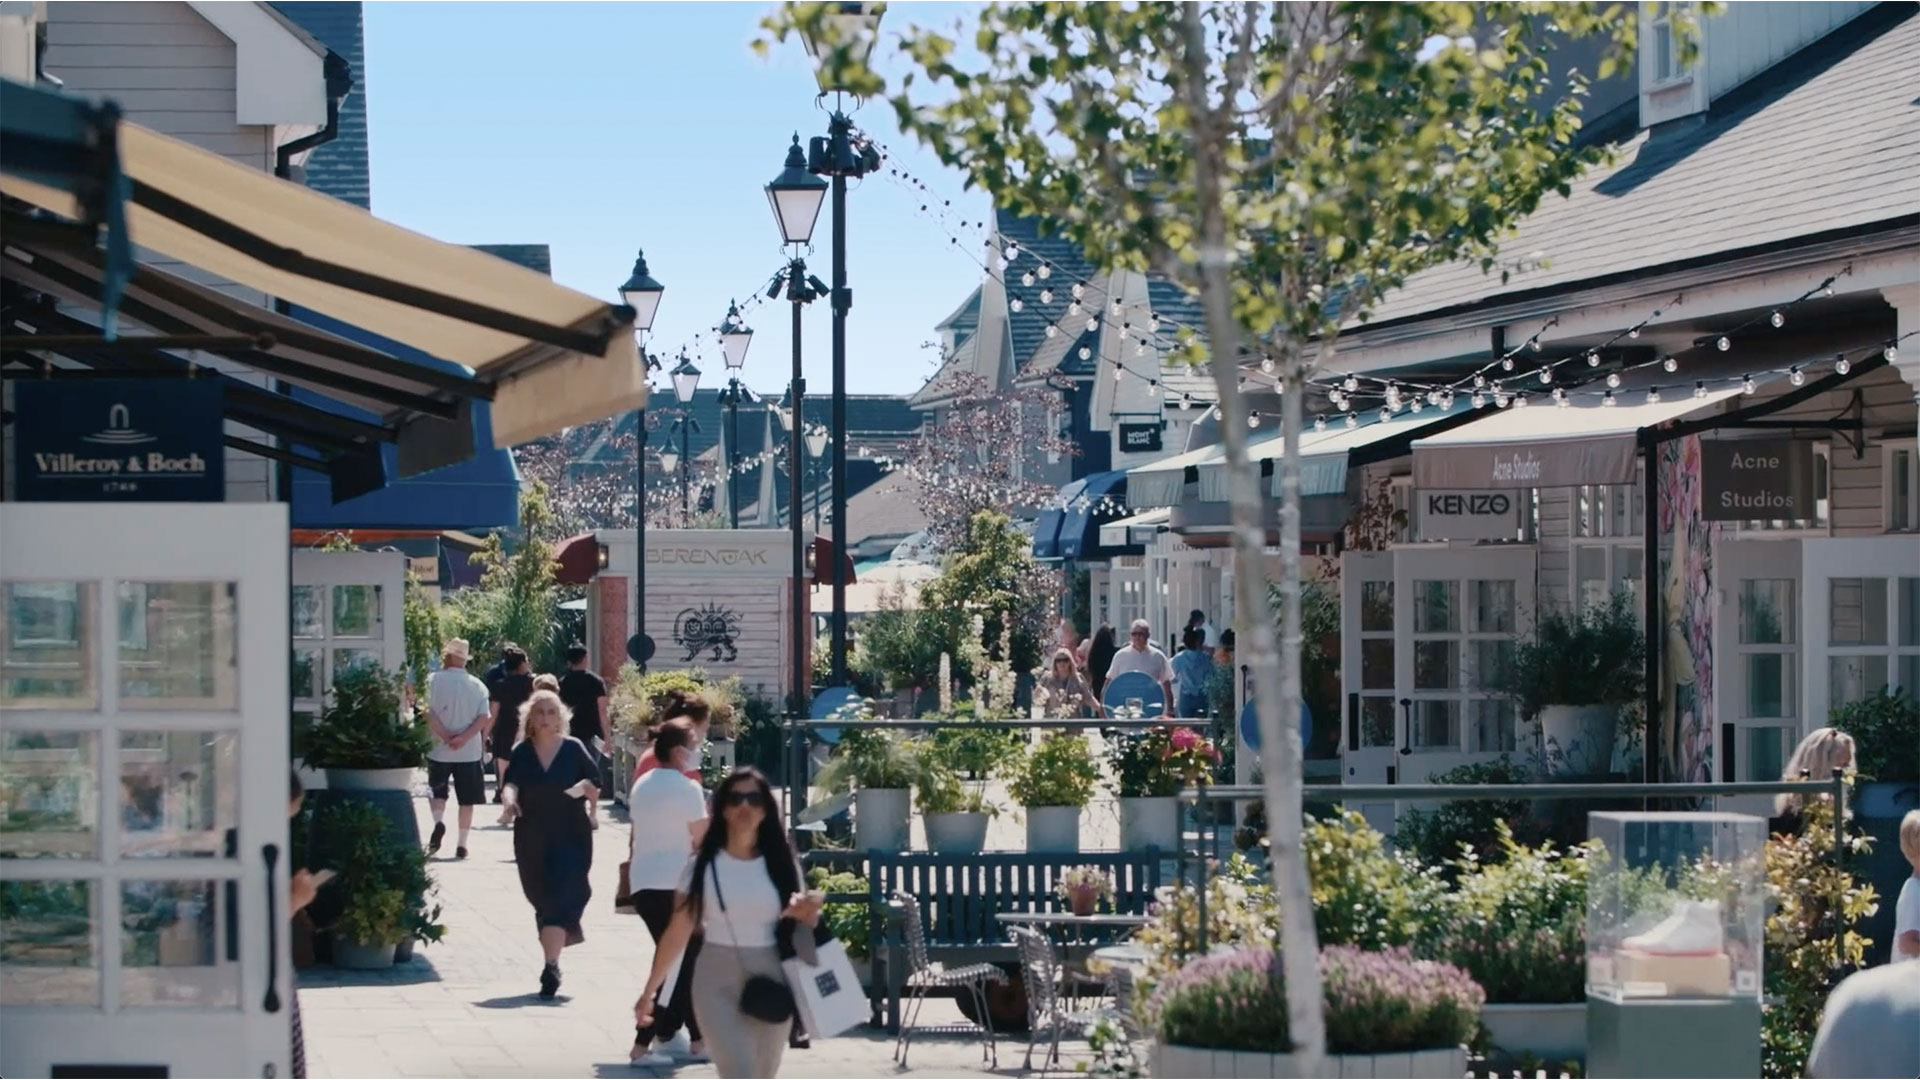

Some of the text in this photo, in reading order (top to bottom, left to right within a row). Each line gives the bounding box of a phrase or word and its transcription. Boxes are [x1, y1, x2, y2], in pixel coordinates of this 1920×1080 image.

[35, 453, 205, 477] Villeroy & Boch
[1731, 452, 1779, 469] Acne
[1429, 494, 1510, 515] KENZO
[1721, 489, 1794, 508] Studios
[646, 548, 768, 565] BERENJAK
